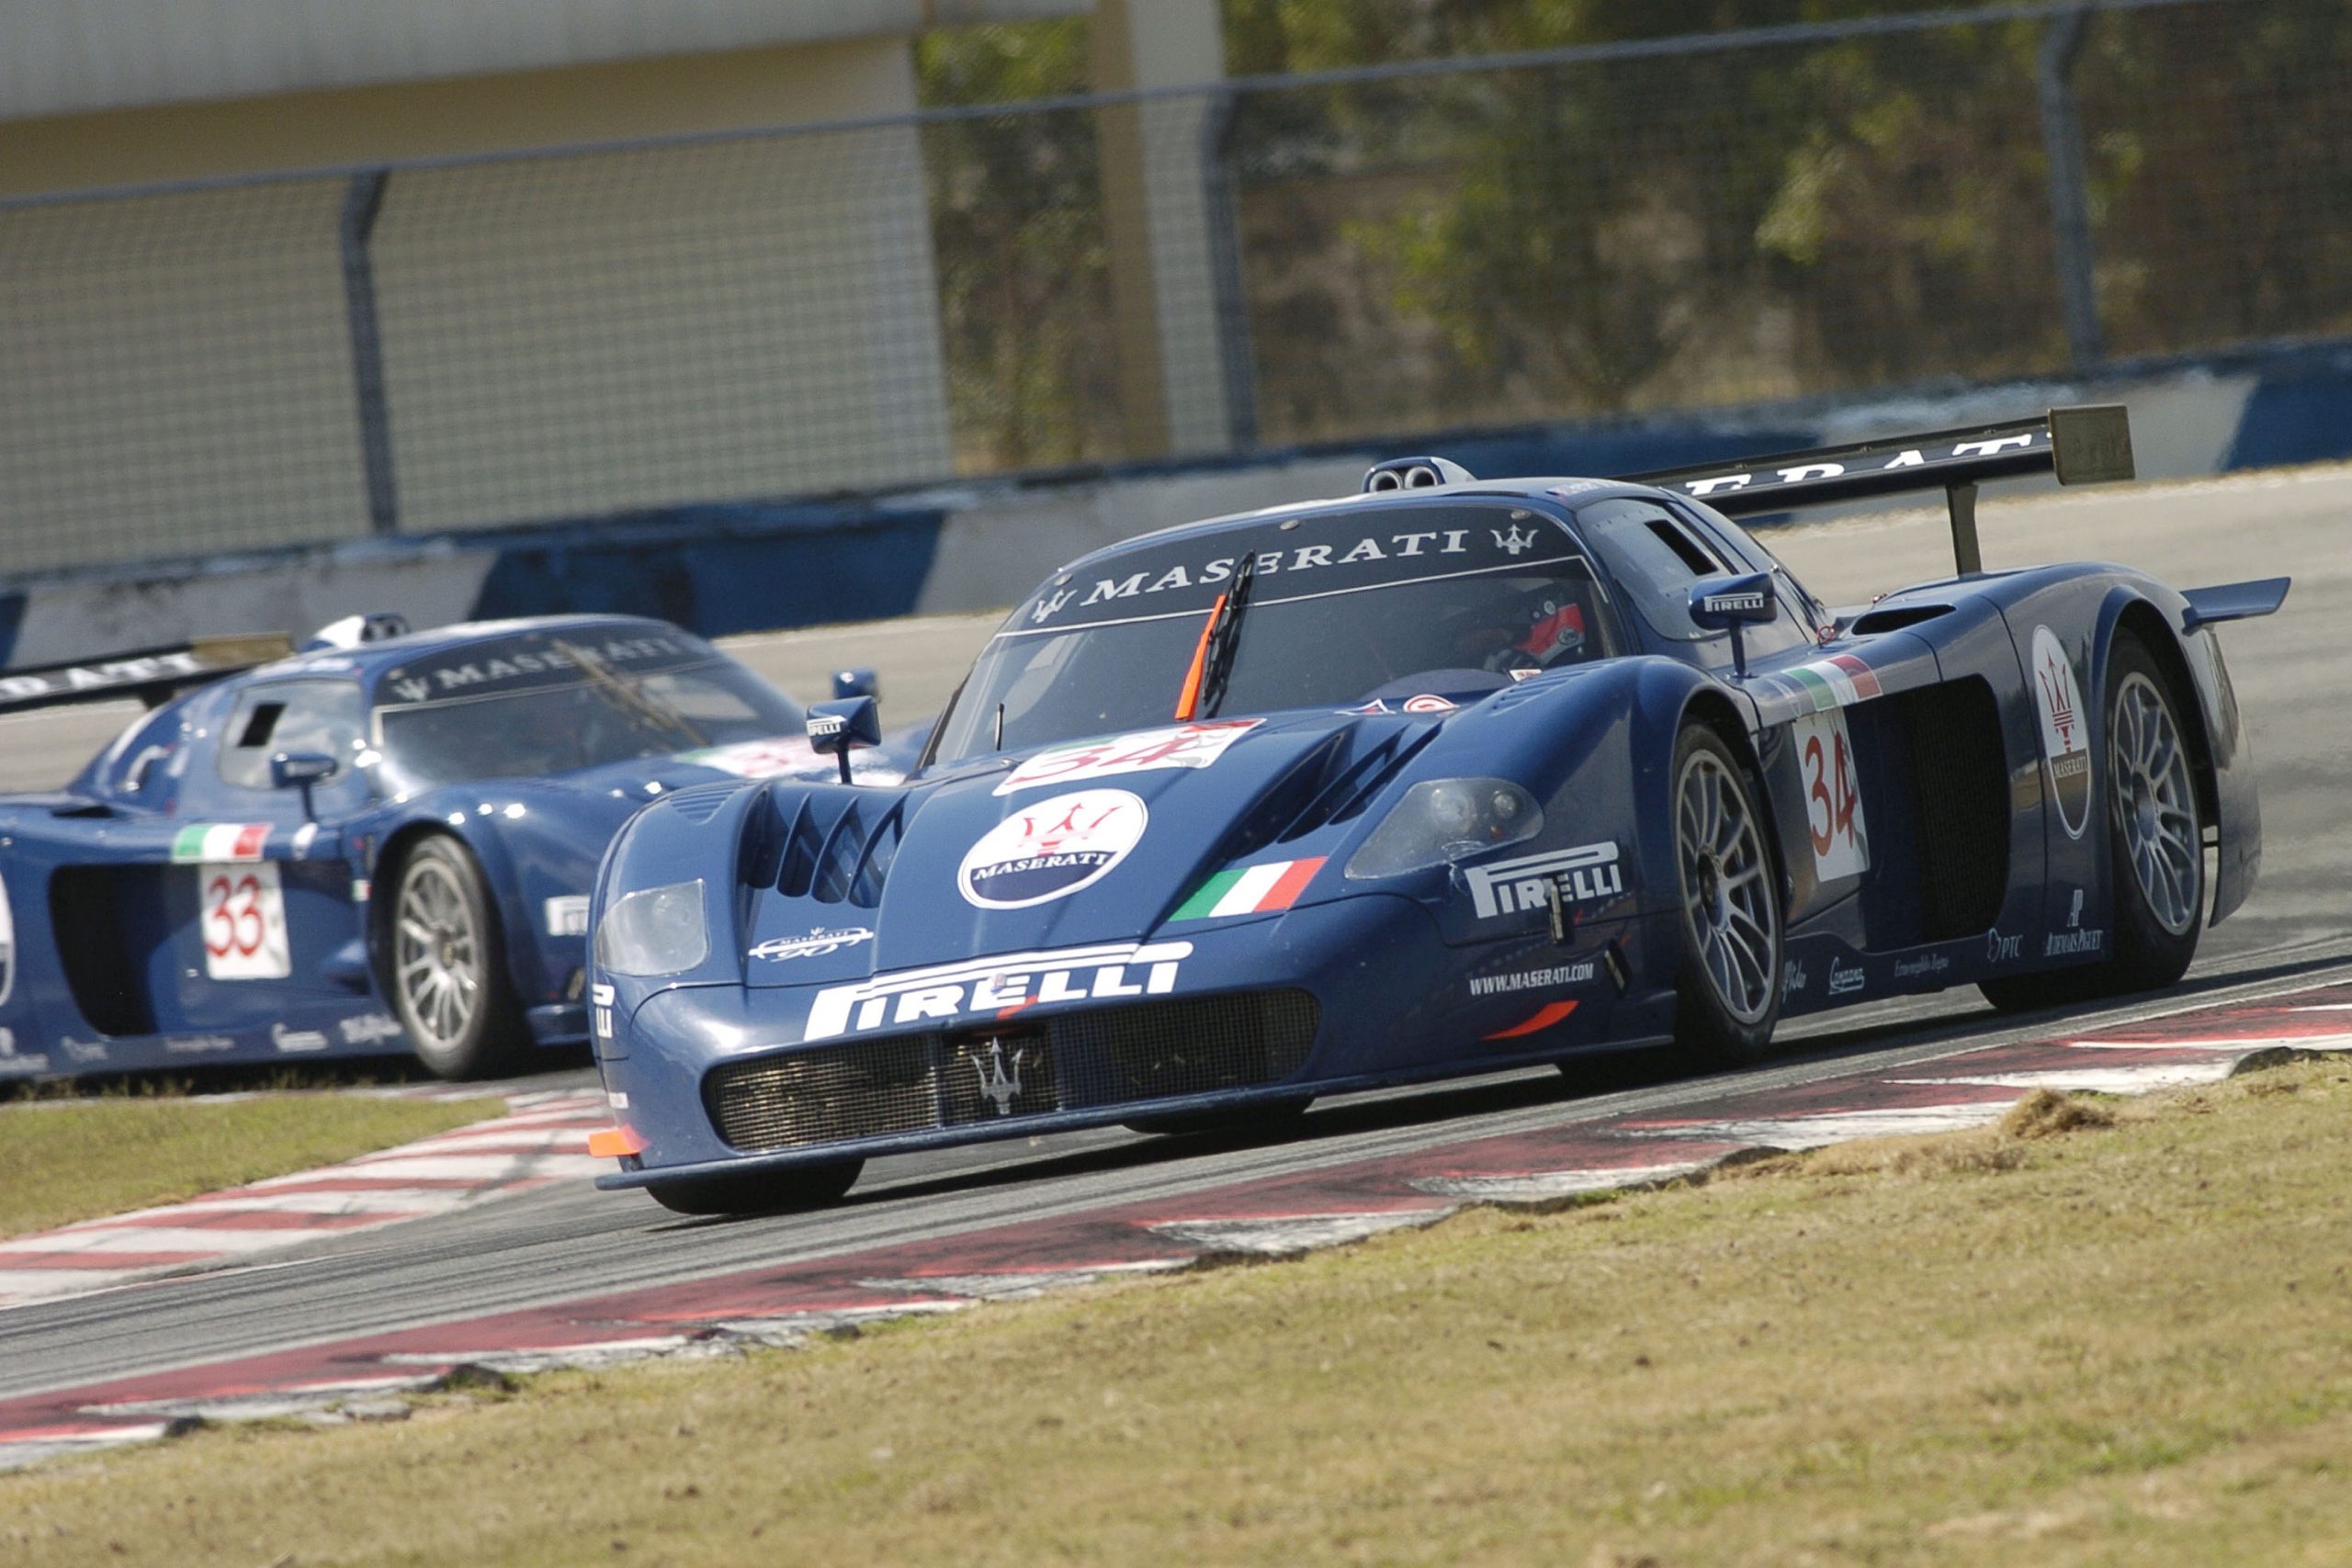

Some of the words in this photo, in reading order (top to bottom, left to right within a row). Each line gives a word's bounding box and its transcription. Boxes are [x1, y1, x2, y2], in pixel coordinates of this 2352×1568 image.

[1079, 530, 1470, 607] MASERATI
[1704, 592, 1764, 613] PIRELLI
[1005, 731, 1202, 786] 34
[1804, 730, 1858, 857] 34
[973, 852, 1110, 881] MASERATI
[1464, 840, 1622, 919] PIRELLI
[205, 874, 264, 957] 33
[803, 941, 1193, 1042] PIRELLI
[1470, 963, 1594, 996] WWW.MASERATI.COM
